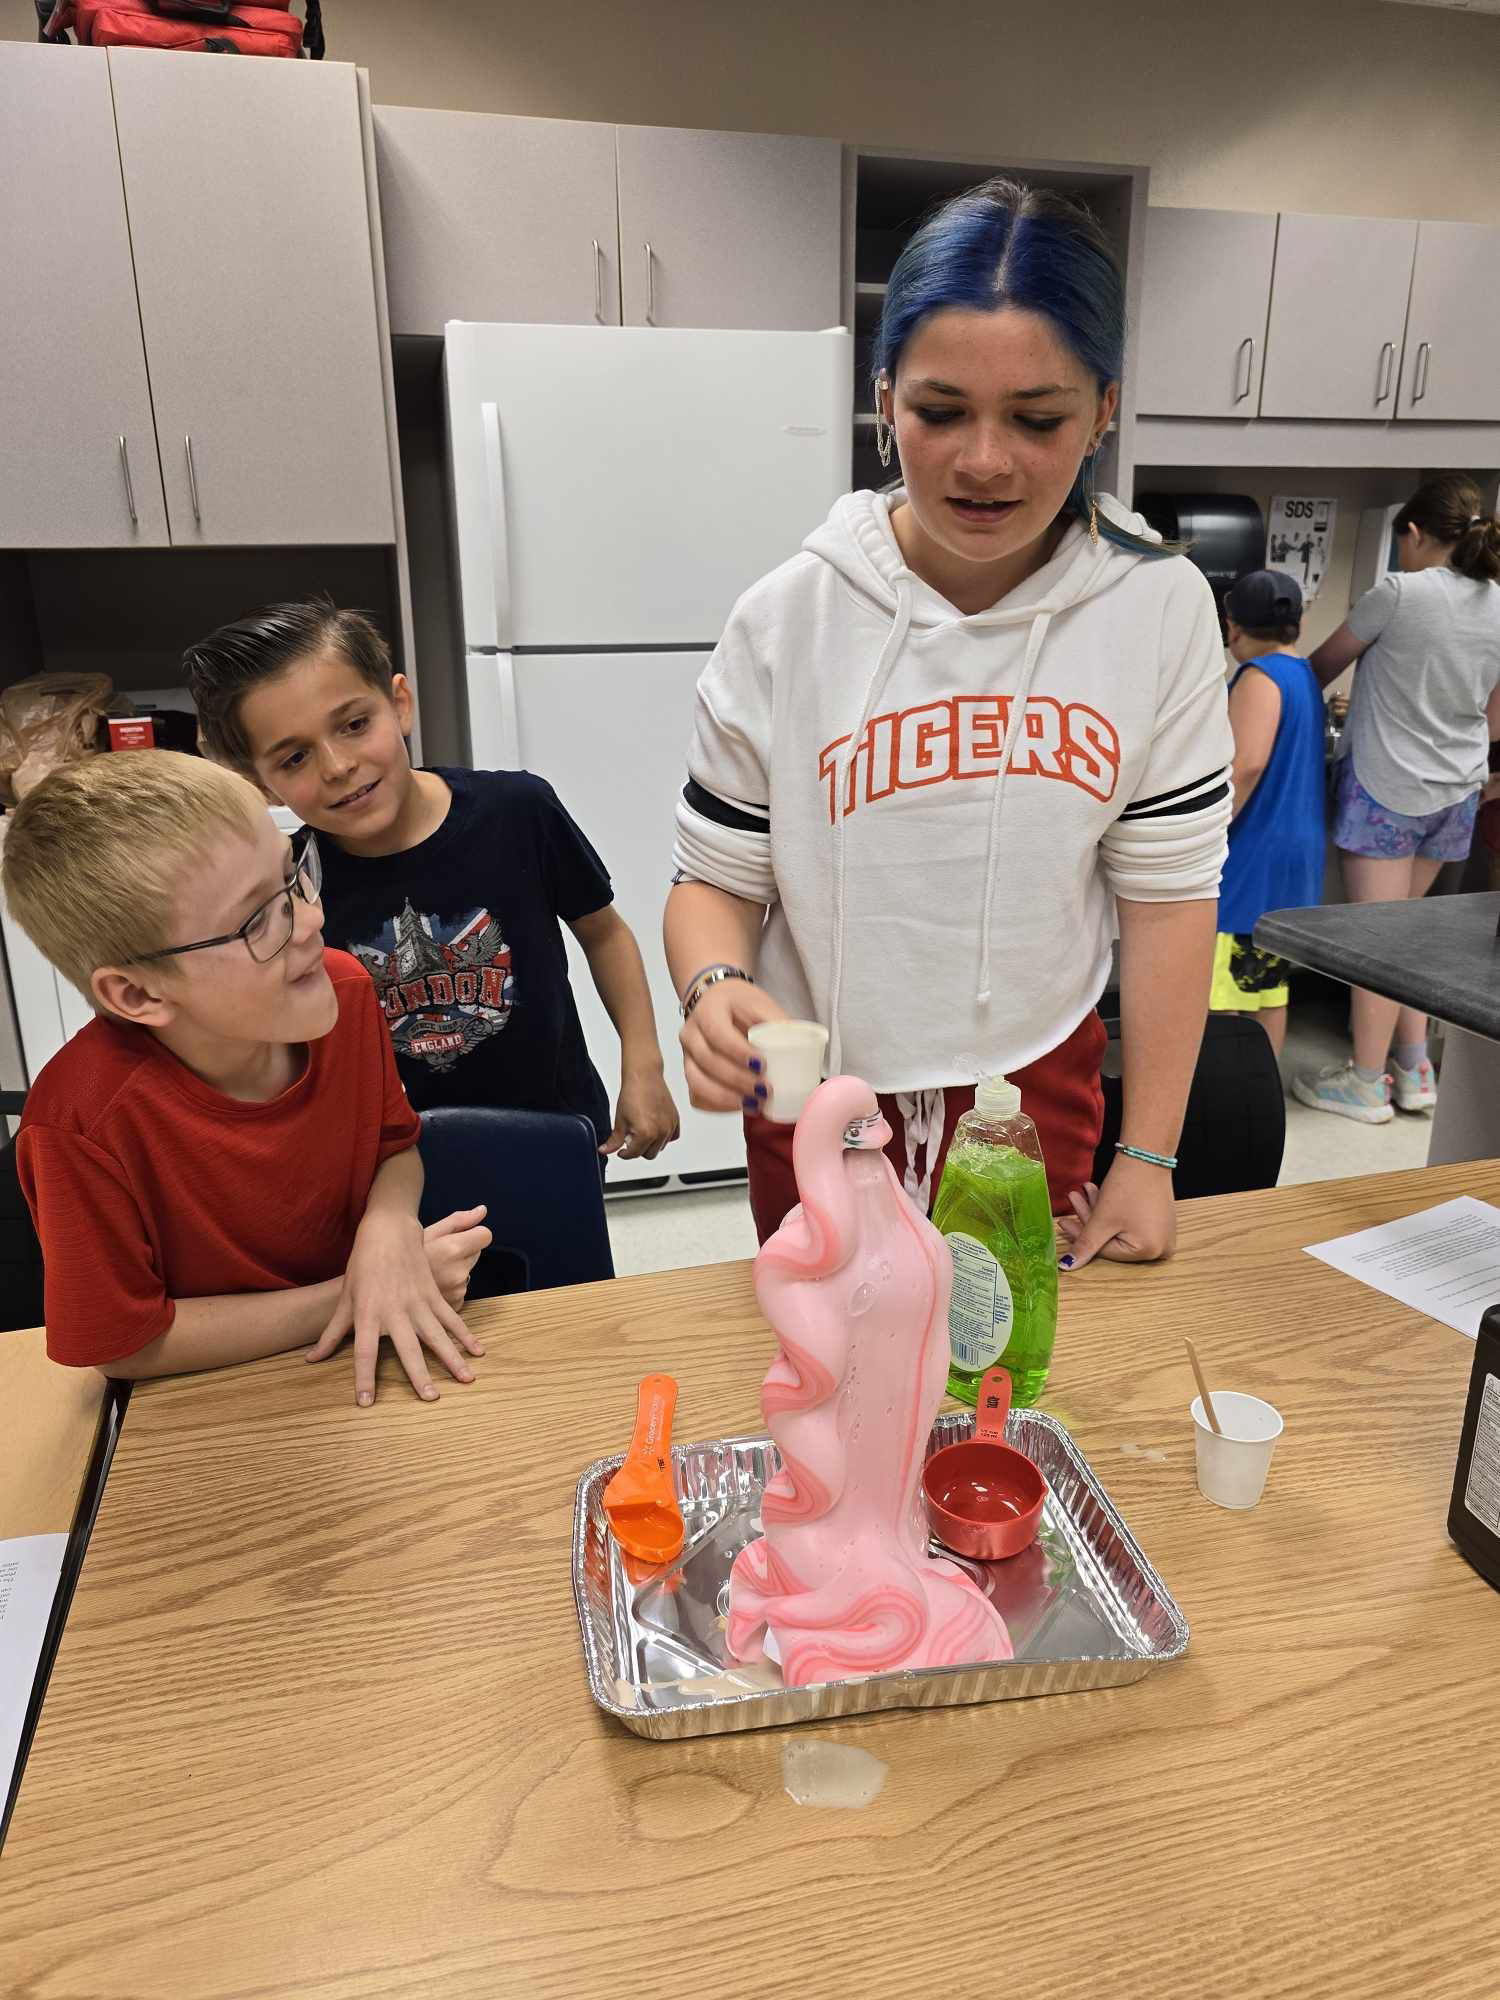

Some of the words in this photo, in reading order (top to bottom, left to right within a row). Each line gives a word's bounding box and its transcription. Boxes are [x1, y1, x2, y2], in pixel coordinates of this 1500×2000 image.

[1284, 500, 1314, 518] SDS
[818, 695, 1120, 825] TIGERS
[385, 966, 506, 1019] ONDON
[414, 1034, 462, 1052] ENGLAND
